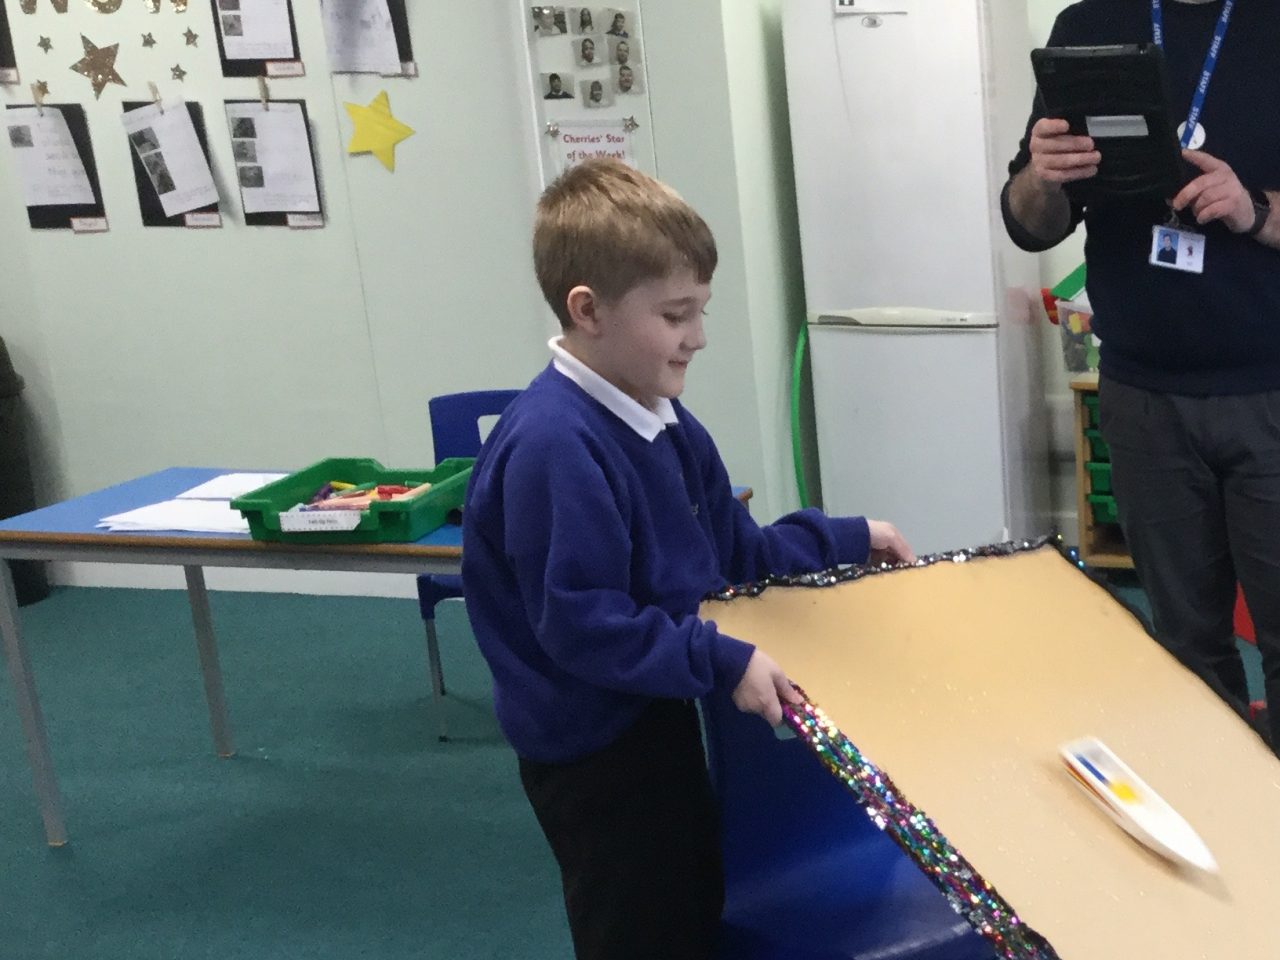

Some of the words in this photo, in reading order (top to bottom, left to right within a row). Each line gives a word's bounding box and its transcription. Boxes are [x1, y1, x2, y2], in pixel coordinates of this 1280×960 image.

[1210, 35, 1221, 59] STAFF
[1199, 70, 1211, 94] STAFF
[1188, 106, 1199, 130] STAFF
[563, 134, 602, 143] Cherries'
[606, 134, 624, 143] Star
[566, 150, 577, 162] of
[578, 150, 593, 160] the
